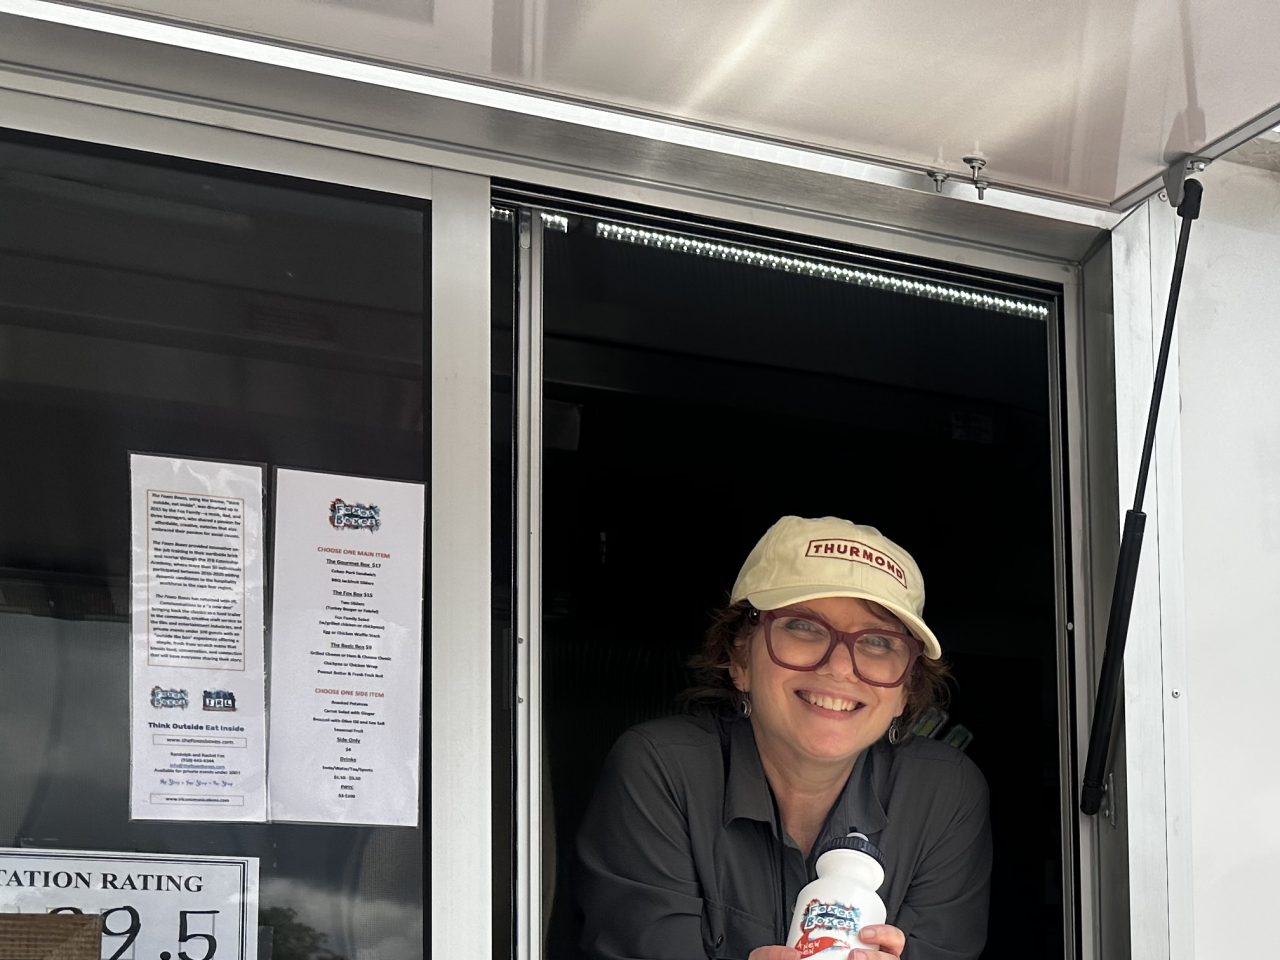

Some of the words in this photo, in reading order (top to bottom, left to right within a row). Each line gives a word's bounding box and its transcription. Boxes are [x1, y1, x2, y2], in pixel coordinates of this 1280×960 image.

[813, 543, 903, 579] THURMOND
[206, 698, 232, 706] IRL
[102, 873, 203, 893] RATING
